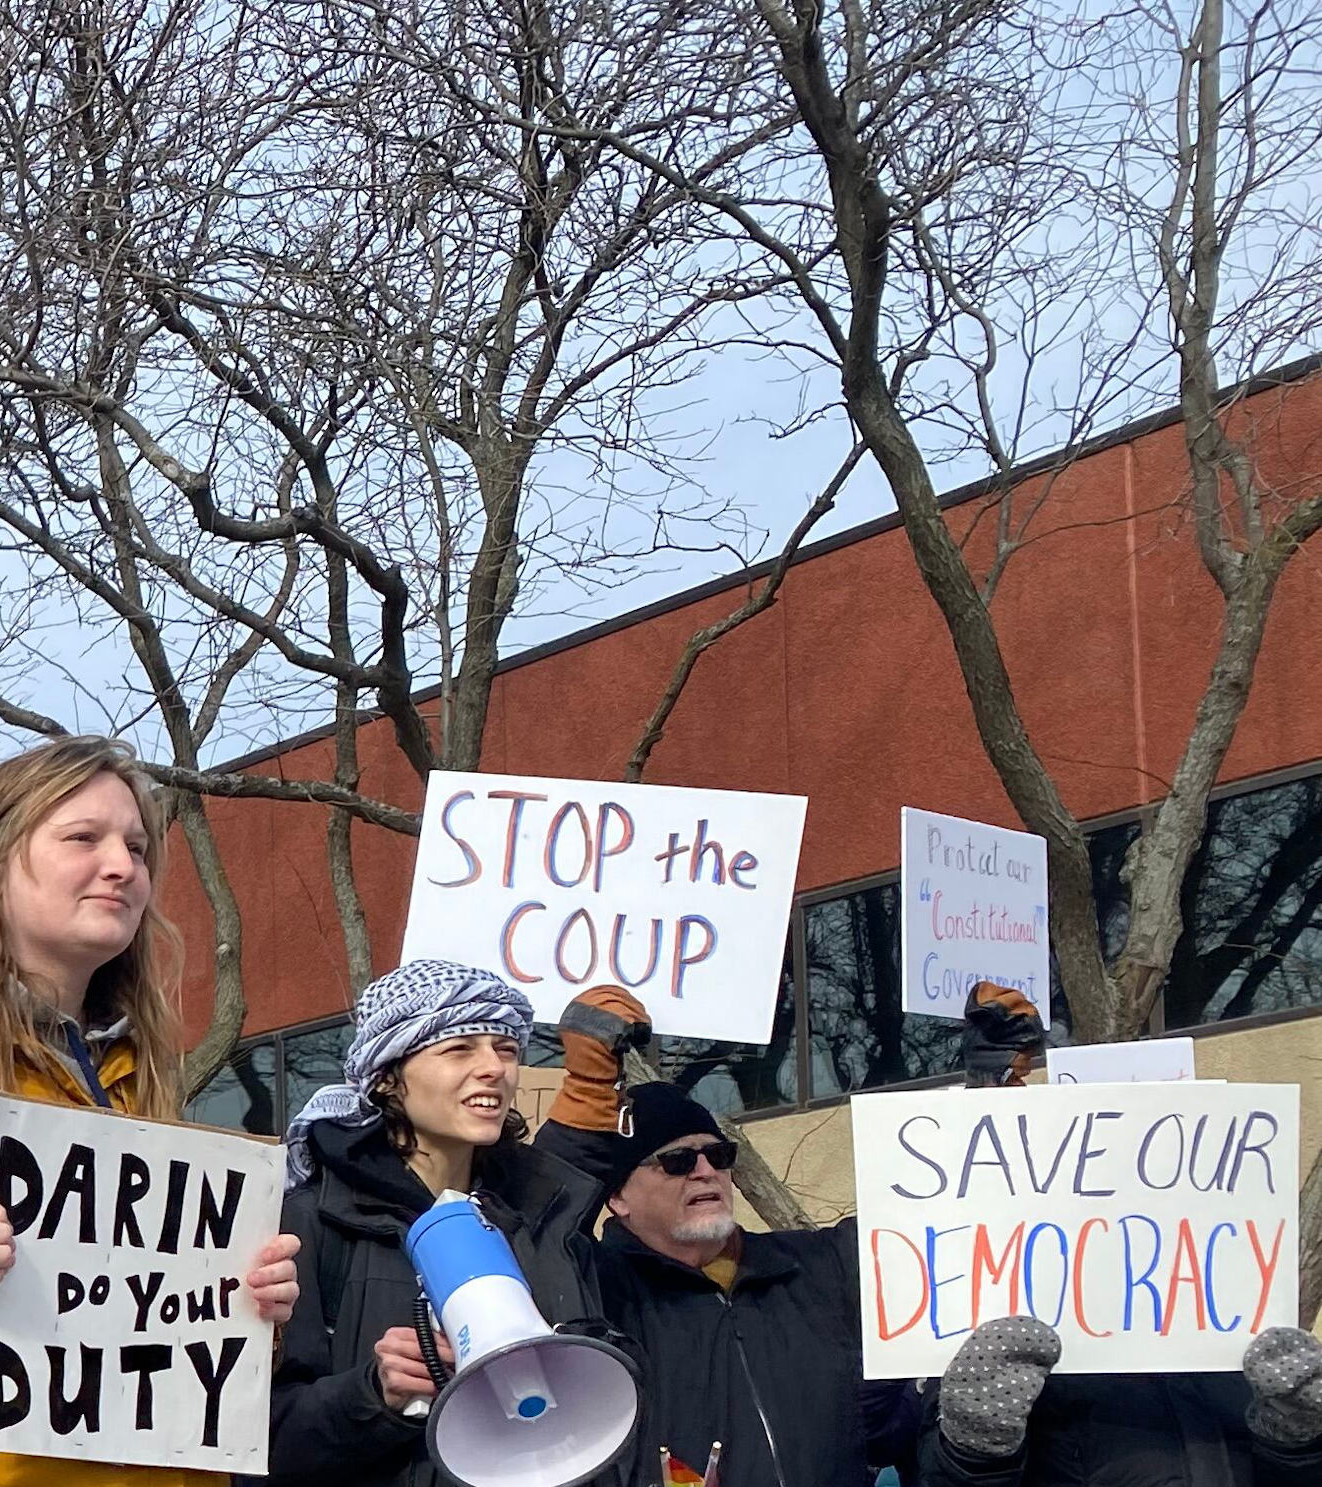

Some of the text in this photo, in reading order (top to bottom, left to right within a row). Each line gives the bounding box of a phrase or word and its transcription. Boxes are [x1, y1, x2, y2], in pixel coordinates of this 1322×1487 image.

[429, 789, 758, 892] STOP the
[500, 900, 719, 999] COUP
[891, 1110, 1278, 1200] SAVE OUR
[870, 1212, 1286, 1342] DEMOCRACY
